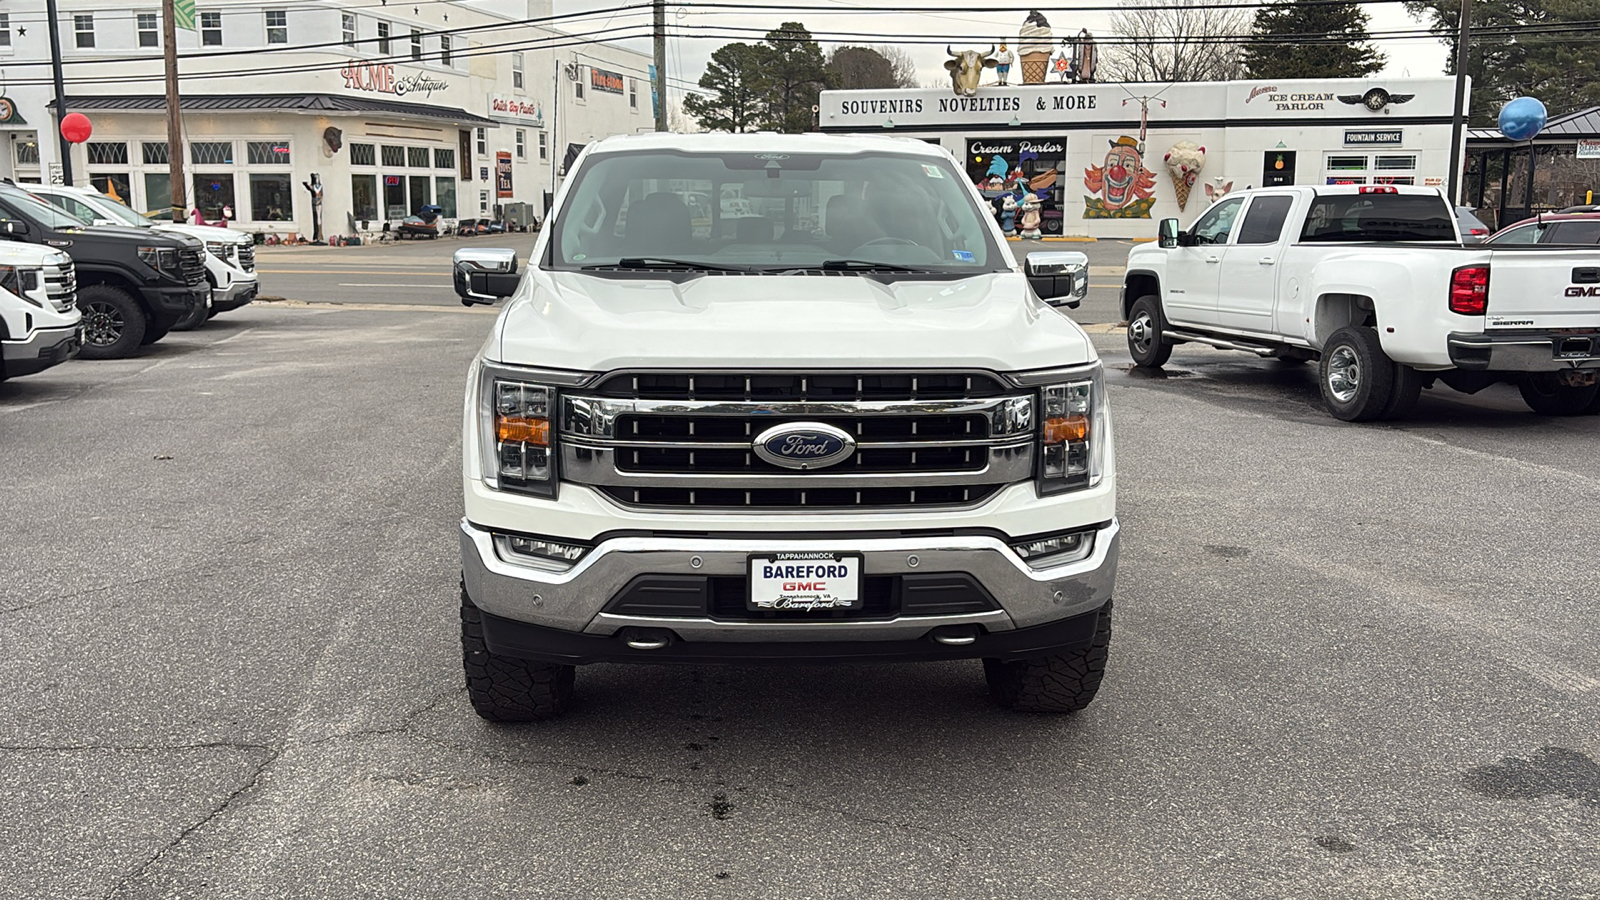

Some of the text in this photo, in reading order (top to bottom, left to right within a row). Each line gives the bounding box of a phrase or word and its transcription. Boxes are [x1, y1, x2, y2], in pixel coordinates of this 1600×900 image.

[341, 58, 395, 93] ACME
[406, 70, 449, 98] Antiques
[1269, 93, 1334, 102] ICE CREAM
[493, 98, 535, 116] Dutch Boy Paints
[841, 94, 1097, 115] SOUVENIRS NOVELTIES & MORE
[1276, 103, 1324, 111] PARLOR
[1346, 133, 1400, 142] FOUNTAIN SERVICE
[970, 141, 1063, 154] Cream Parlor
[52, 175, 64, 185] 25
[500, 177, 511, 189] TEA
[1564, 286, 1600, 298] GMC
[781, 434, 829, 455] Ford
[763, 565, 848, 579] BAREFORD
[782, 582, 826, 591] GMC
[773, 597, 838, 612] Bareford
